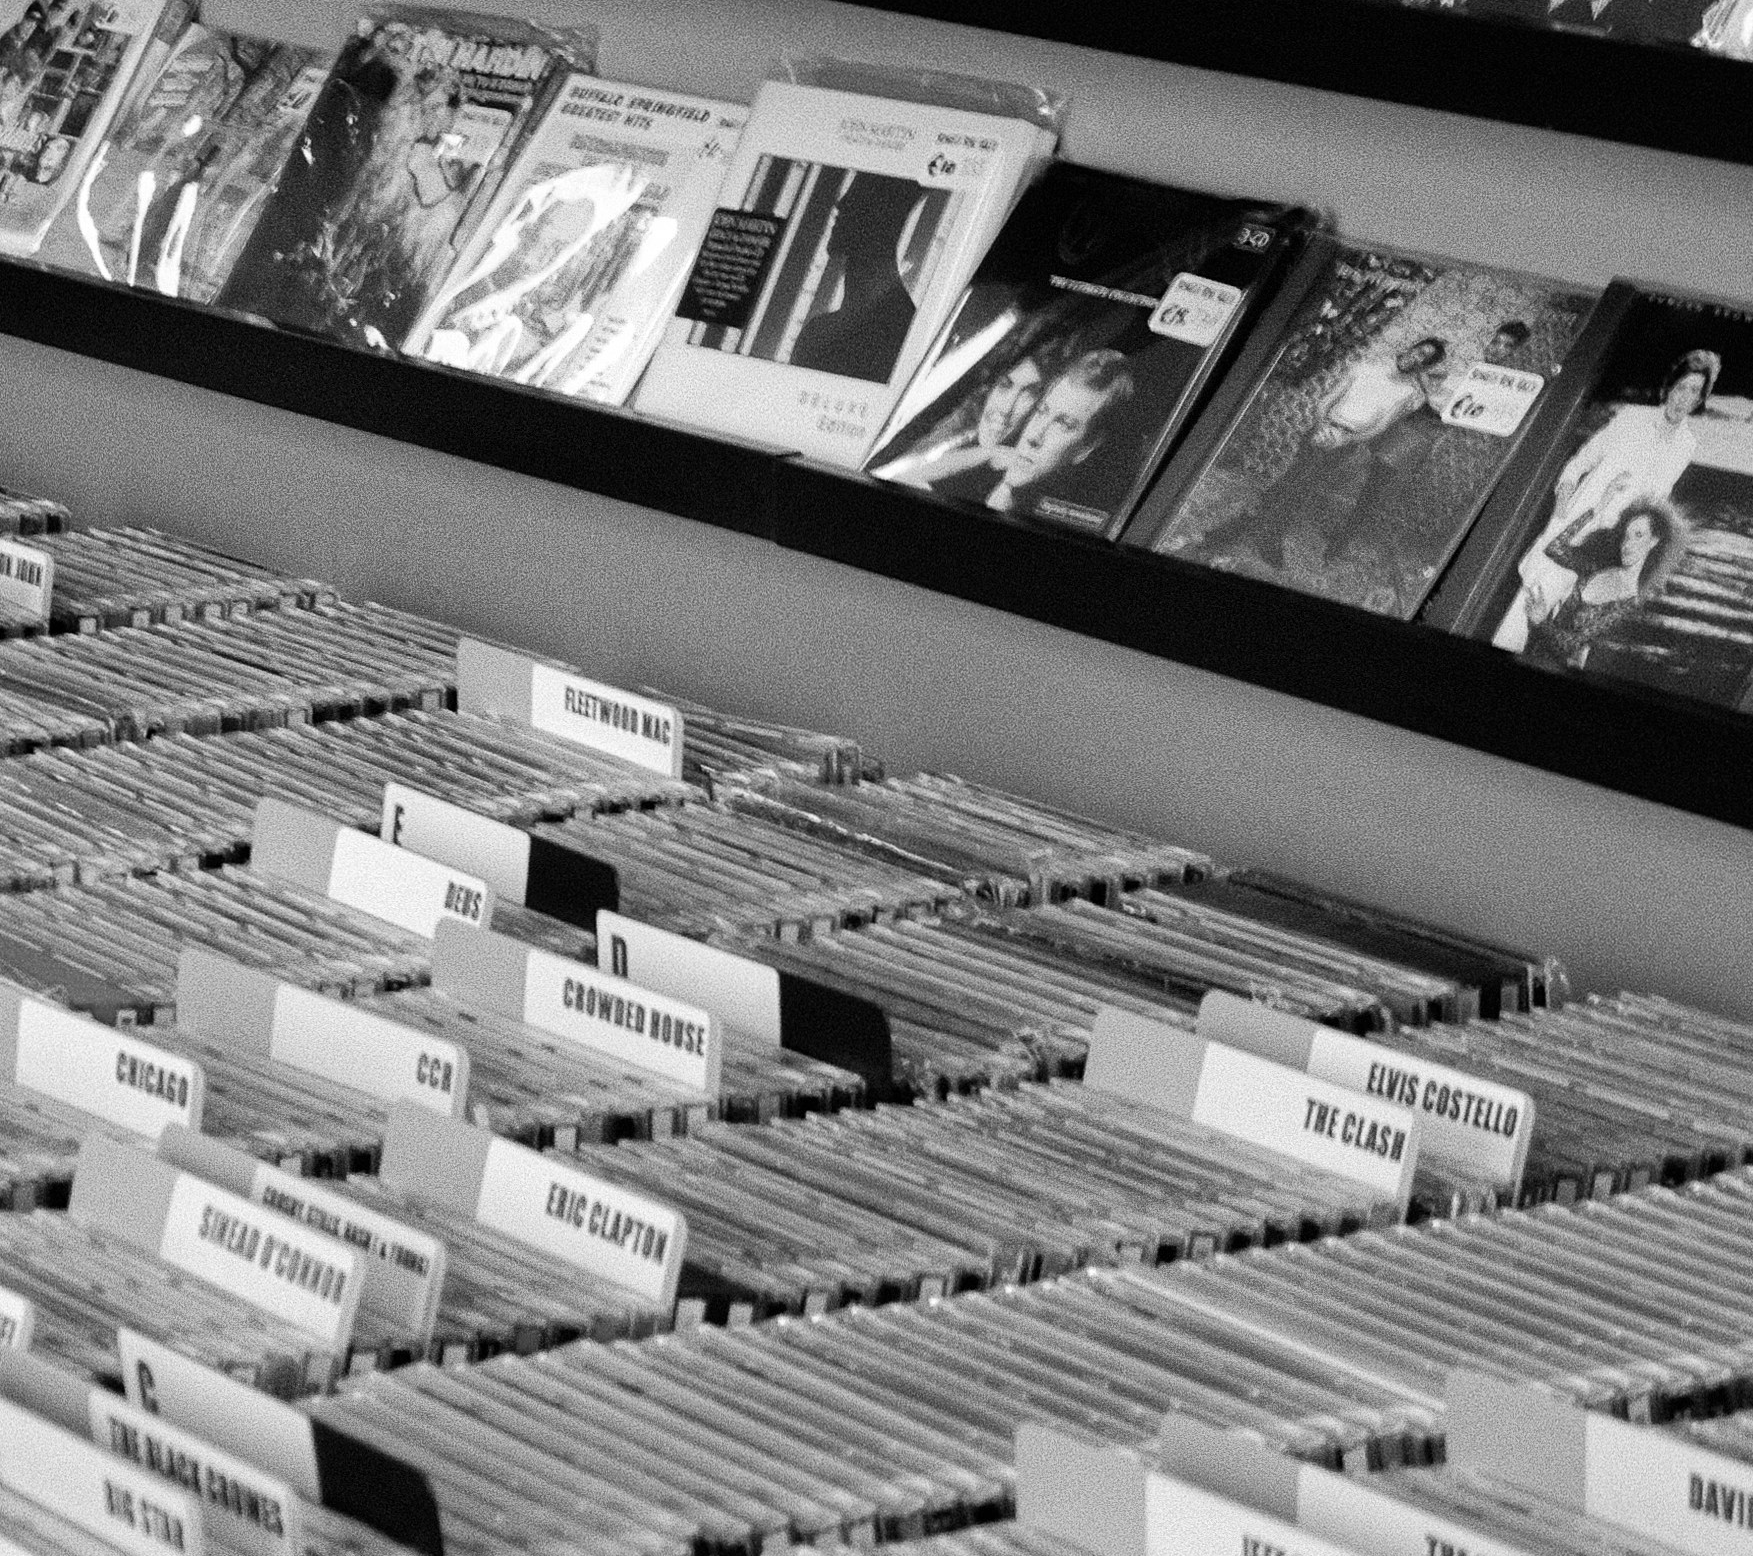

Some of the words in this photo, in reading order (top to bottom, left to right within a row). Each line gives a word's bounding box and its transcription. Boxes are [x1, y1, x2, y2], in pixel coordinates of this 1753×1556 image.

[627, 93, 712, 127] SPRINGFIELD
[564, 686, 640, 735] FLEETWOOD
[640, 712, 673, 746] MAC
[562, 978, 648, 1038] CROWDED
[649, 1004, 706, 1057] HOUSE
[115, 1050, 189, 1111] CHICAGO
[417, 1050, 452, 1095] CCR
[1367, 1060, 1421, 1107] ELVIS
[1422, 1076, 1519, 1140] COSTELLO
[1304, 1097, 1341, 1140] THE
[1341, 1111, 1408, 1164] CLASH
[198, 1203, 261, 1266] SINEAD
[260, 1226, 348, 1307] O'CONNOR
[546, 1182, 588, 1233] ERIC
[588, 1198, 667, 1266] CLAPTON
[104, 1479, 136, 1529] BIG
[138, 1497, 186, 1555] STAR
